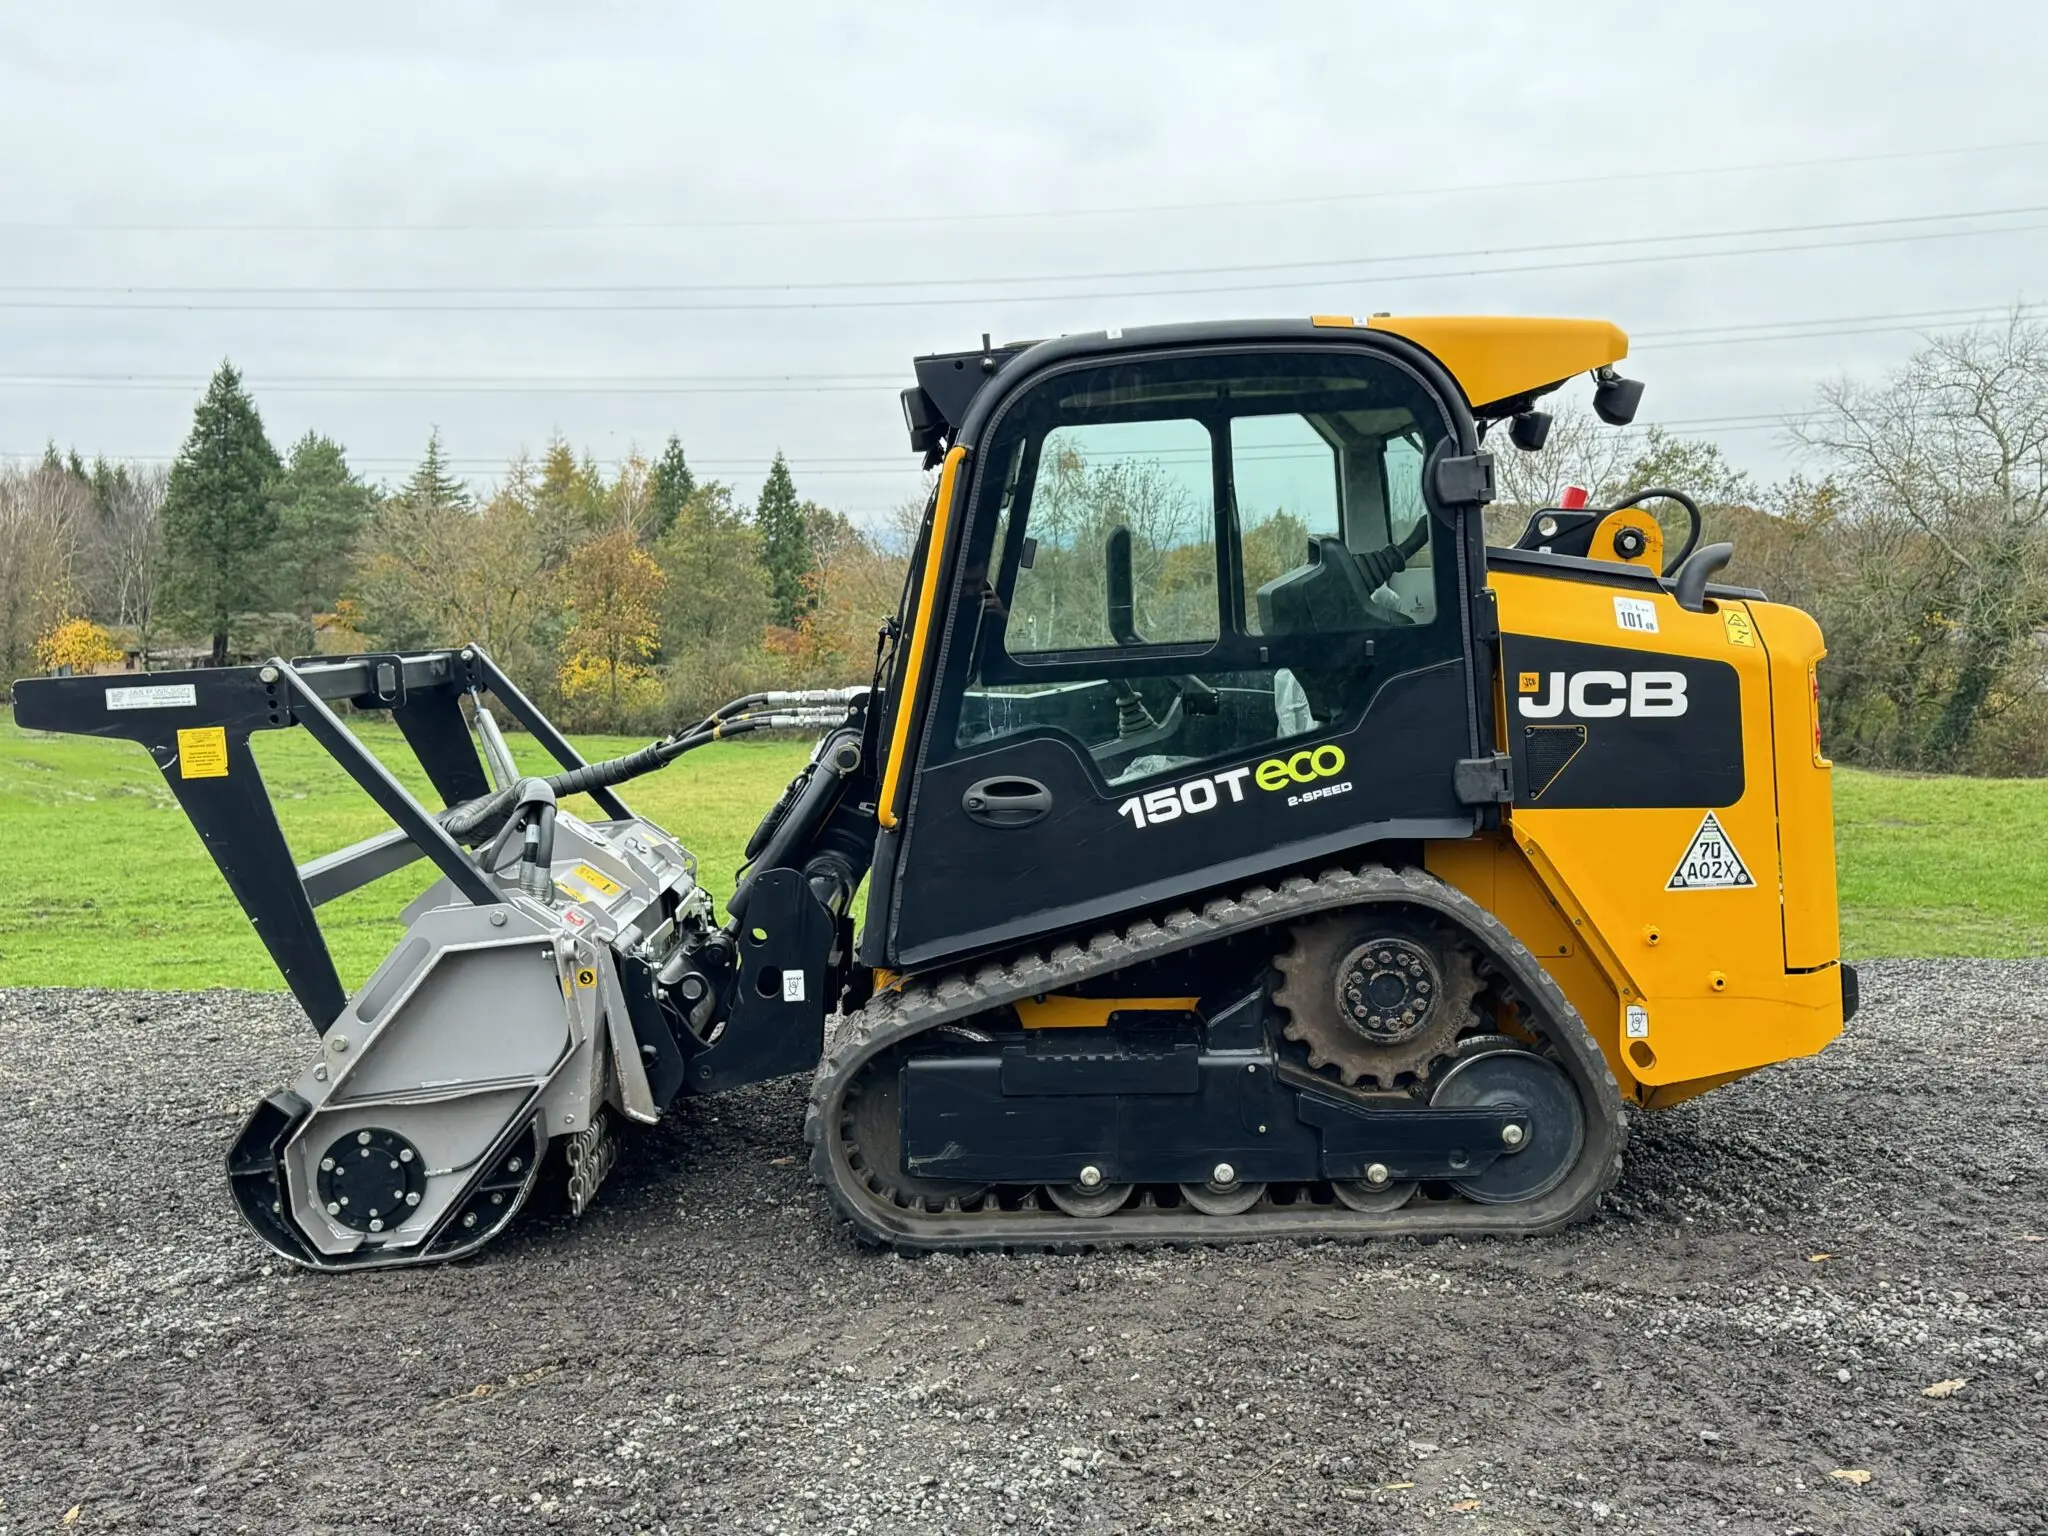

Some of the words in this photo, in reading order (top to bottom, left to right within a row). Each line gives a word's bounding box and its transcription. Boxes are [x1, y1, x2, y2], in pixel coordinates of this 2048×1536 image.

[1621, 611, 1643, 628] 101
[1518, 670, 1688, 718] JCB
[1118, 767, 1250, 829] 150T
[1255, 745, 1345, 791] eco
[1287, 781, 1353, 807] 2-SPEED
[1699, 841, 1721, 860] 70
